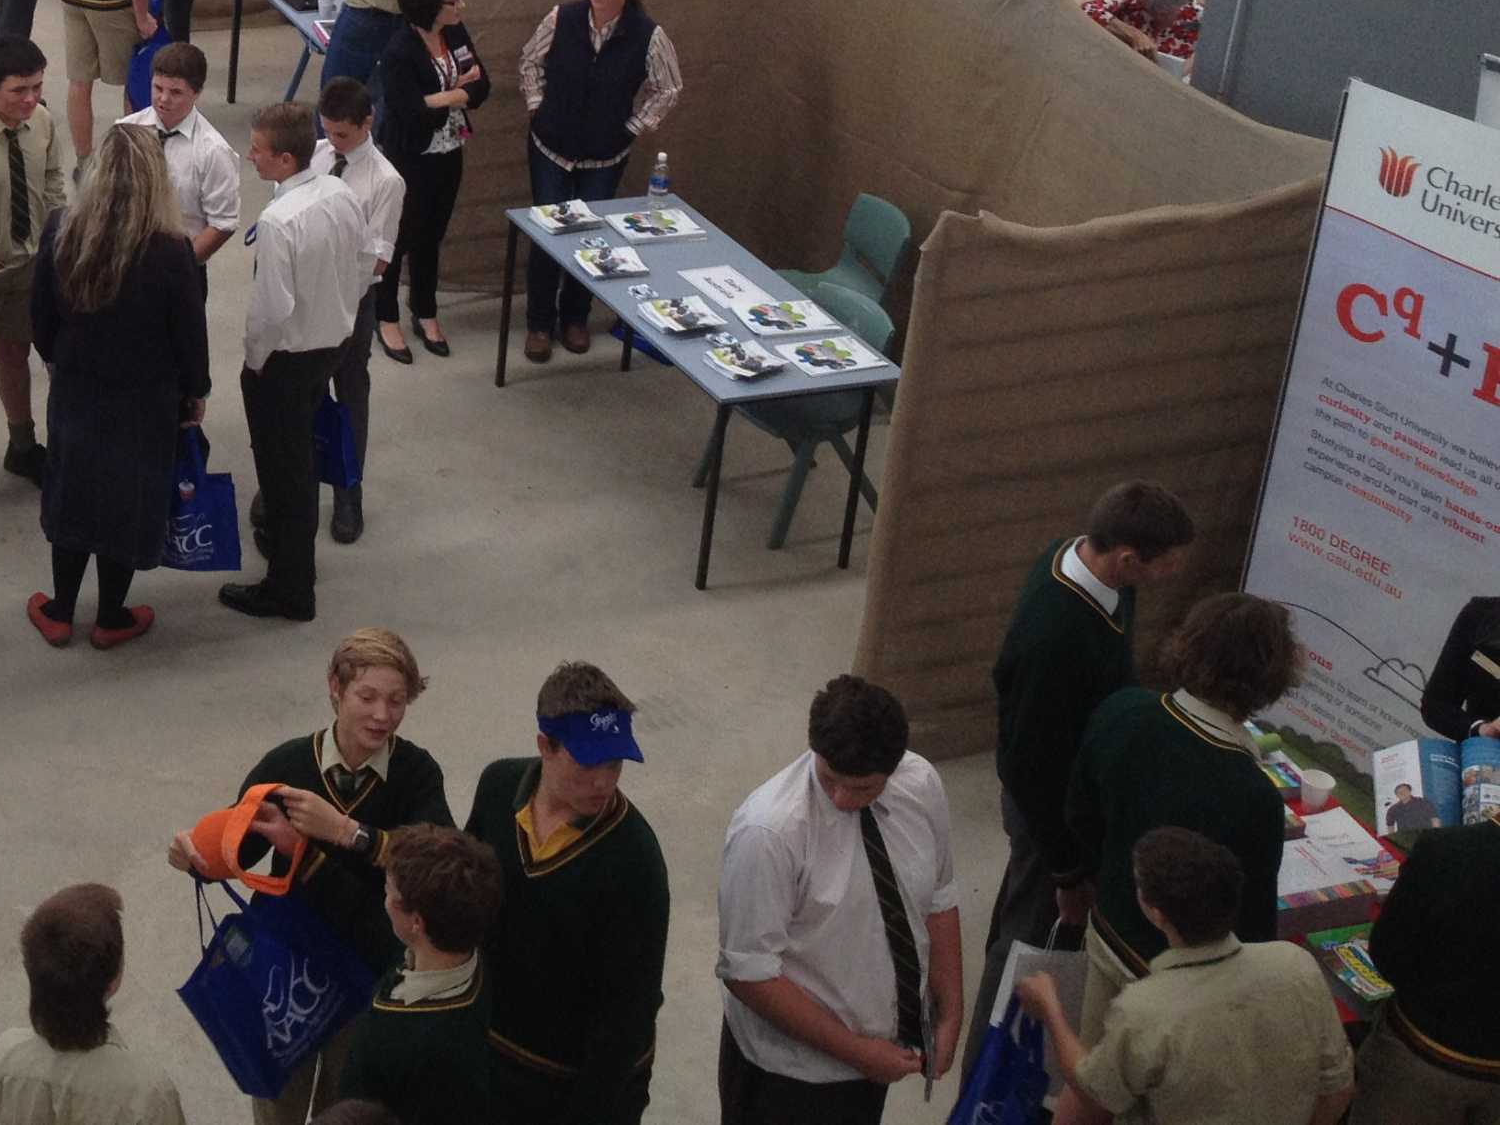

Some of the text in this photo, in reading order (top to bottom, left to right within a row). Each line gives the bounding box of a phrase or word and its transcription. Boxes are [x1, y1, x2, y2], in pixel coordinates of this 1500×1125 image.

[1427, 167, 1500, 211] Charle
[1315, 407, 1331, 422] the
[1333, 418, 1356, 433] path
[1358, 428, 1369, 439] to
[1369, 436, 1412, 461] greater
[1316, 394, 1371, 425] curiosity
[1372, 419, 1392, 435] and
[1393, 430, 1438, 459] passion
[1464, 468, 1477, 479] us
[1480, 474, 1493, 486] all
[1335, 382, 1372, 407] Charles
[1374, 401, 1399, 421] Sturt
[1400, 416, 1449, 448] University
[1451, 444, 1467, 455] we
[1303, 461, 1343, 486] campus
[1307, 446, 1485, 544] experience and be part of a vibrant
[1310, 428, 1354, 459] Studying
[1356, 453, 1366, 463] at
[1368, 457, 1393, 476] CSU
[1420, 488, 1443, 504] gain
[1287, 532, 1403, 600] www.csu.edu.au
[1293, 515, 1391, 576] 1800 DEGREE
